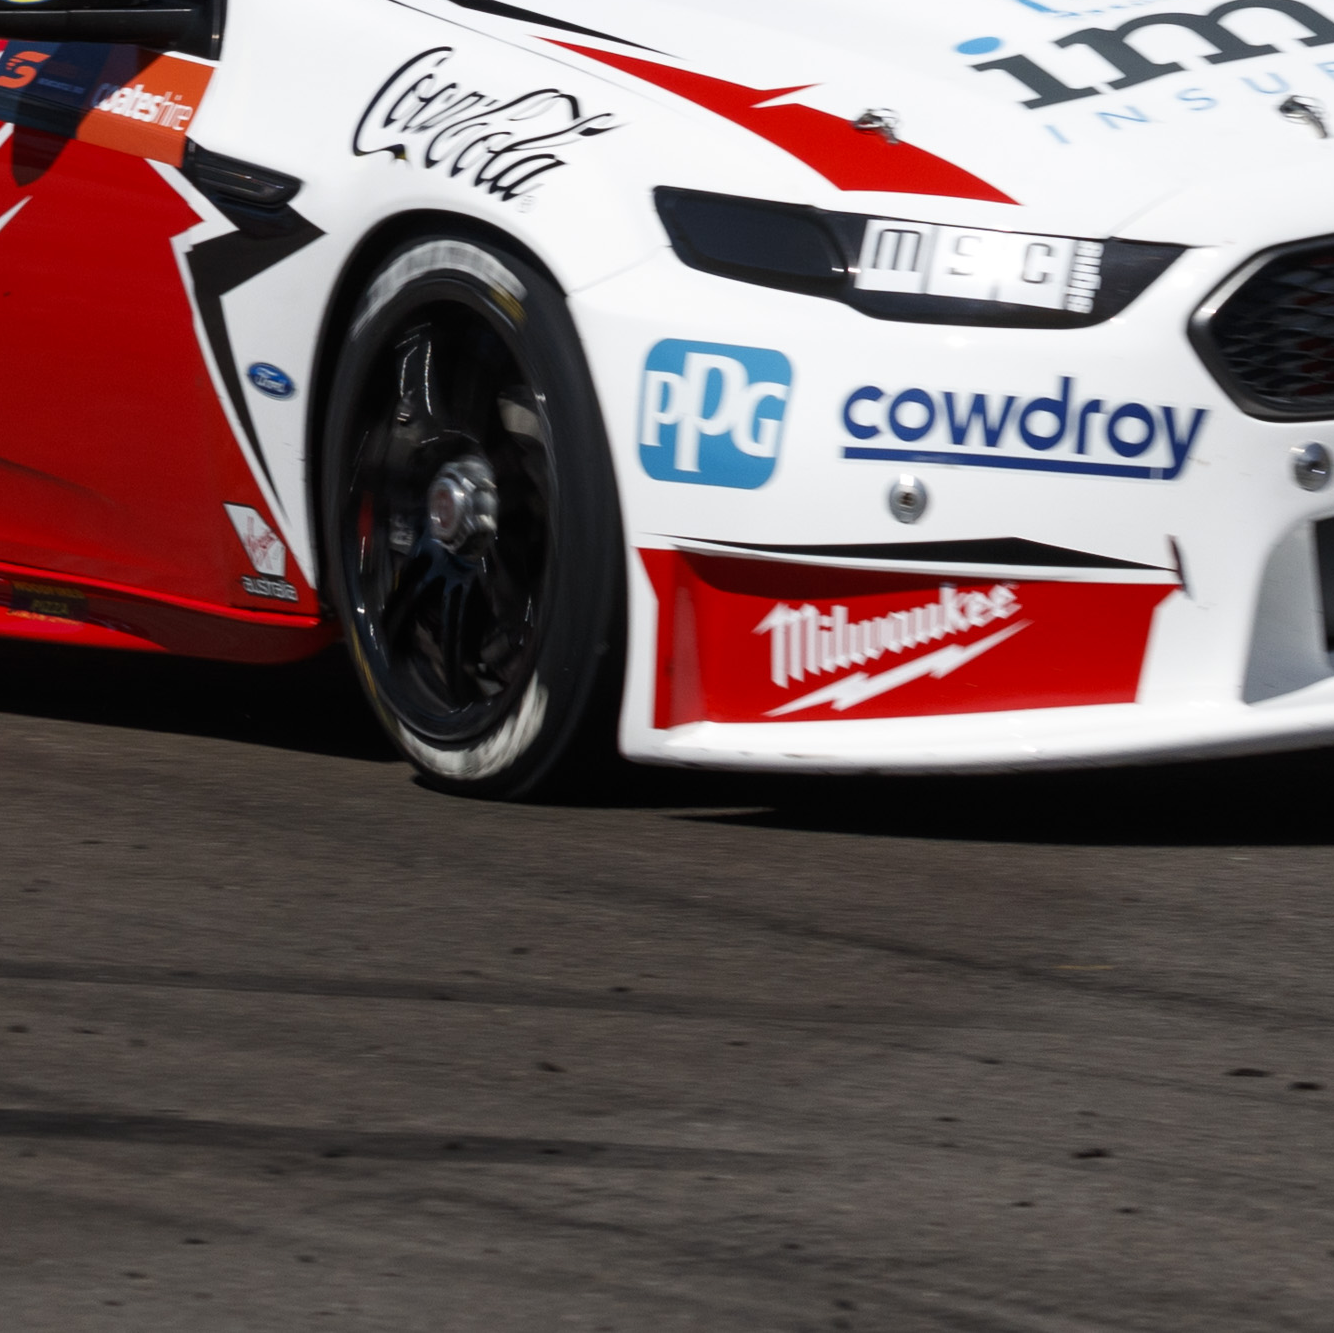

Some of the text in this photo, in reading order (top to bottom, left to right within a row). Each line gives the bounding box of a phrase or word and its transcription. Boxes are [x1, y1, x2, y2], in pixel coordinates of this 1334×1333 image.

[639, 351, 789, 473] PPG
[842, 376, 1208, 481] cowdroy
[242, 576, 299, 602] australia
[751, 582, 1024, 690] Milwaukee
